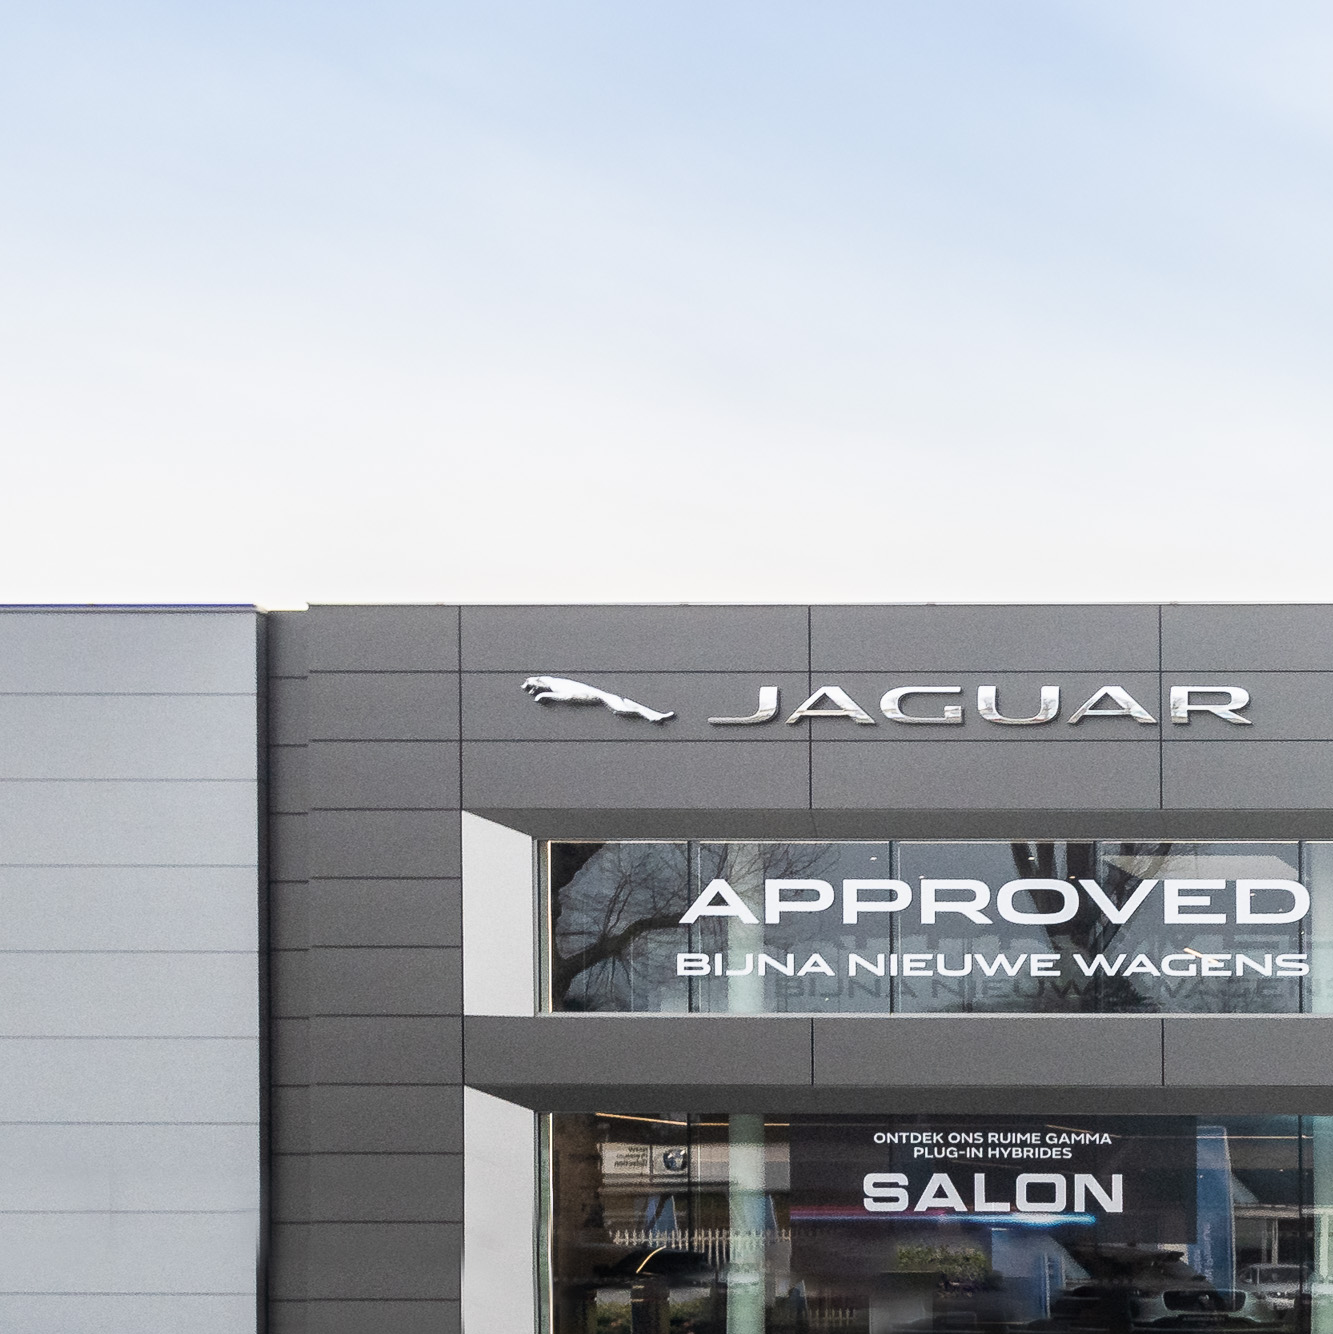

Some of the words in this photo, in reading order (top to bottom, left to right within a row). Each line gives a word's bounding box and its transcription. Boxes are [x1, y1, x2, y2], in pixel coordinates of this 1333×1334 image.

[707, 685, 1253, 725] JAGUAR
[678, 878, 1311, 925] APPROVED
[676, 953, 836, 977] BIJNA
[847, 953, 1062, 977] NIEUWE
[1073, 953, 1310, 977] WAGENS
[873, 1132, 944, 1144] ONTDEK
[948, 1132, 984, 1144] ONS
[988, 1132, 1041, 1144] RUIME
[1045, 1132, 1112, 1145] GAMMA
[913, 1147, 983, 1159] PLUG-IN
[988, 1147, 1073, 1159] HYBRIDES
[862, 1172, 1123, 1213] SALON
